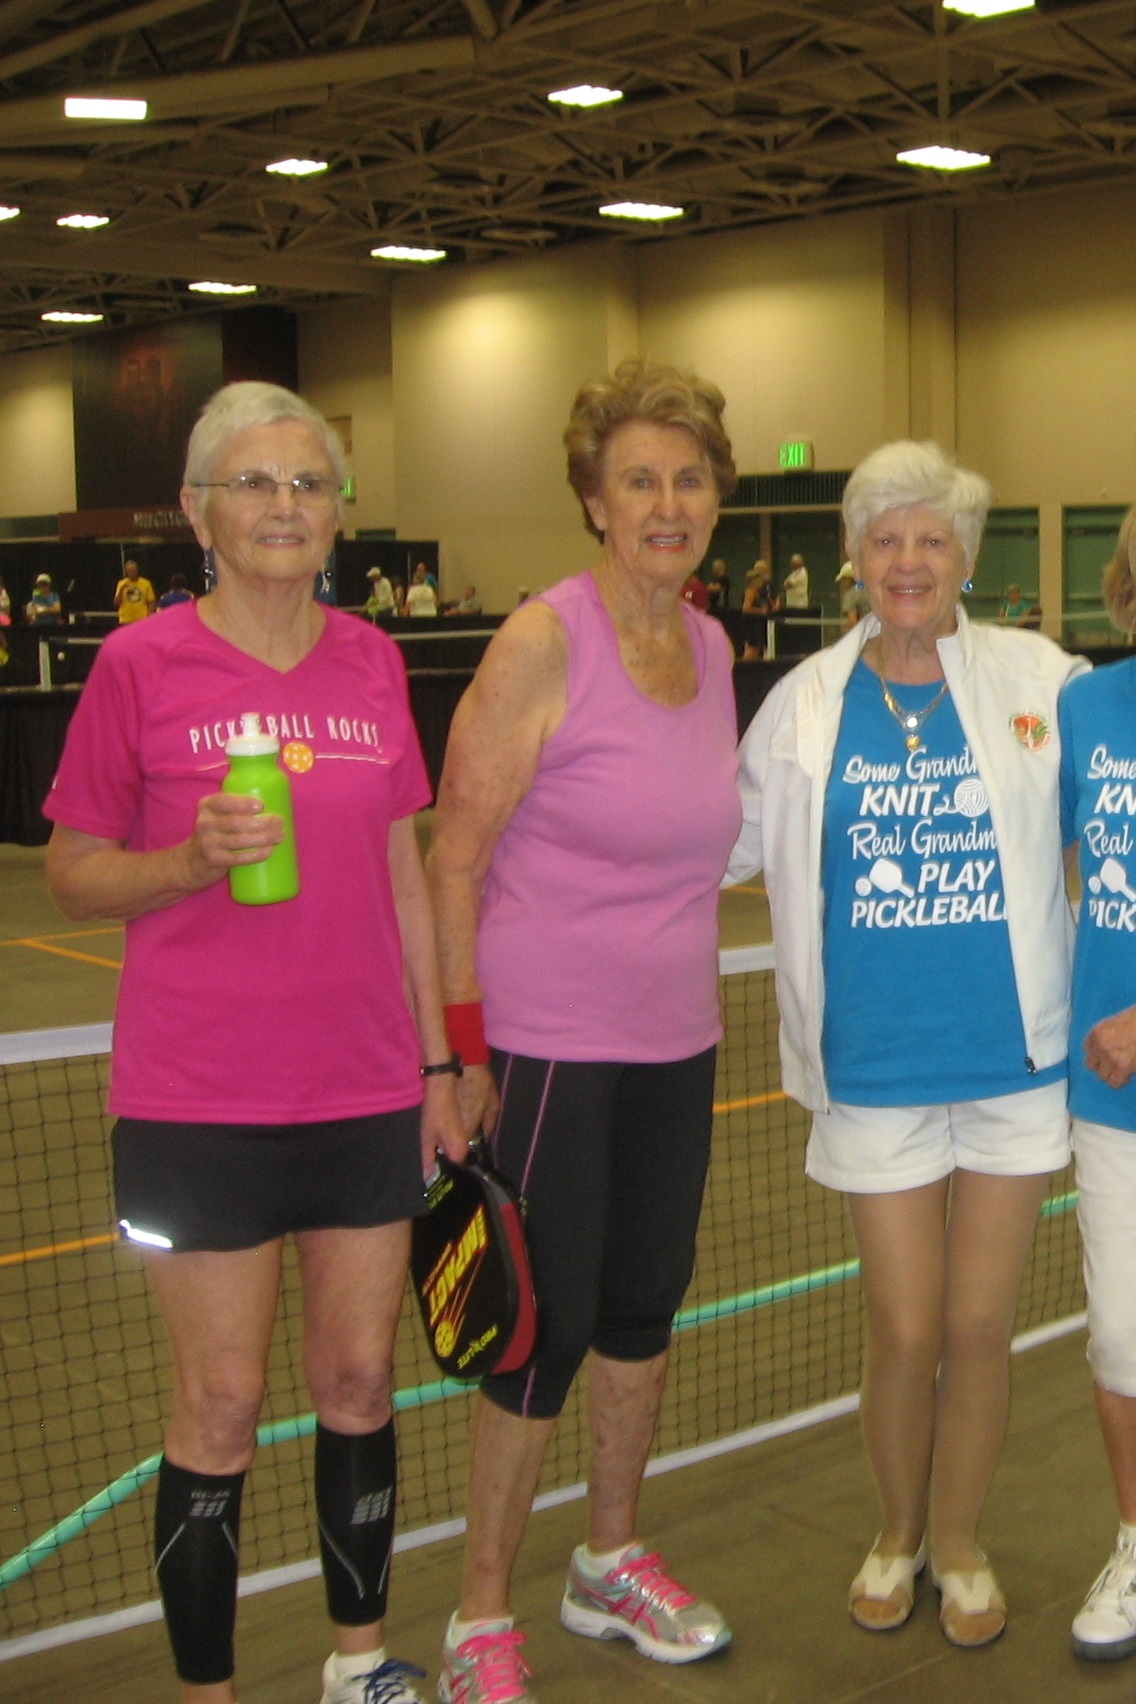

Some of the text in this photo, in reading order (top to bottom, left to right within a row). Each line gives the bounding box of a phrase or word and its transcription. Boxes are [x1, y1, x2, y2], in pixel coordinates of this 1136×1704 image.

[189, 713, 380, 754] PICKBALL ROCKS
[842, 754, 901, 784] Some
[859, 784, 940, 817] KNIT
[847, 818, 997, 860] Real Grandm
[1084, 819, 1133, 857] Real
[918, 860, 995, 893] PLAY
